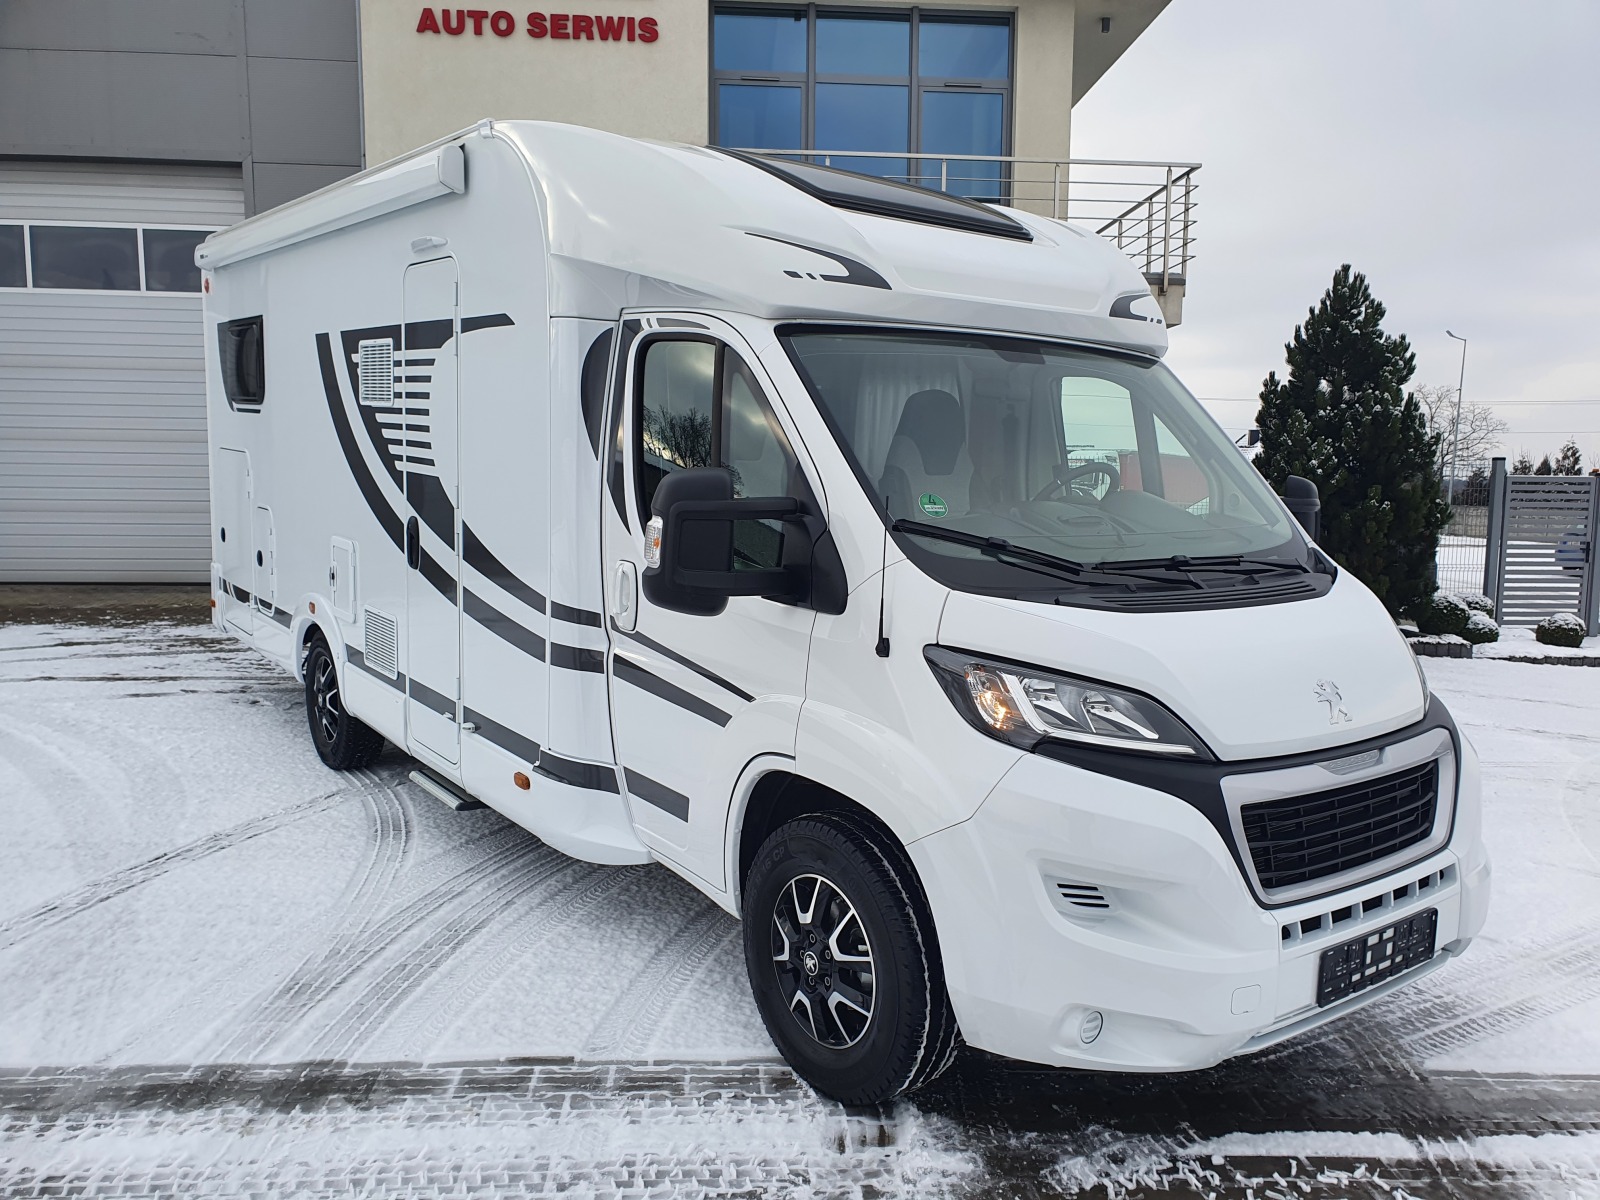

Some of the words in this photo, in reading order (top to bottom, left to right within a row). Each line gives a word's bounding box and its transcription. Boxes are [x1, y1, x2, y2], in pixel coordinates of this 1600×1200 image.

[417, 8, 515, 37] AUTO
[527, 12, 659, 43] SERWIS
[929, 494, 936, 505] 4
